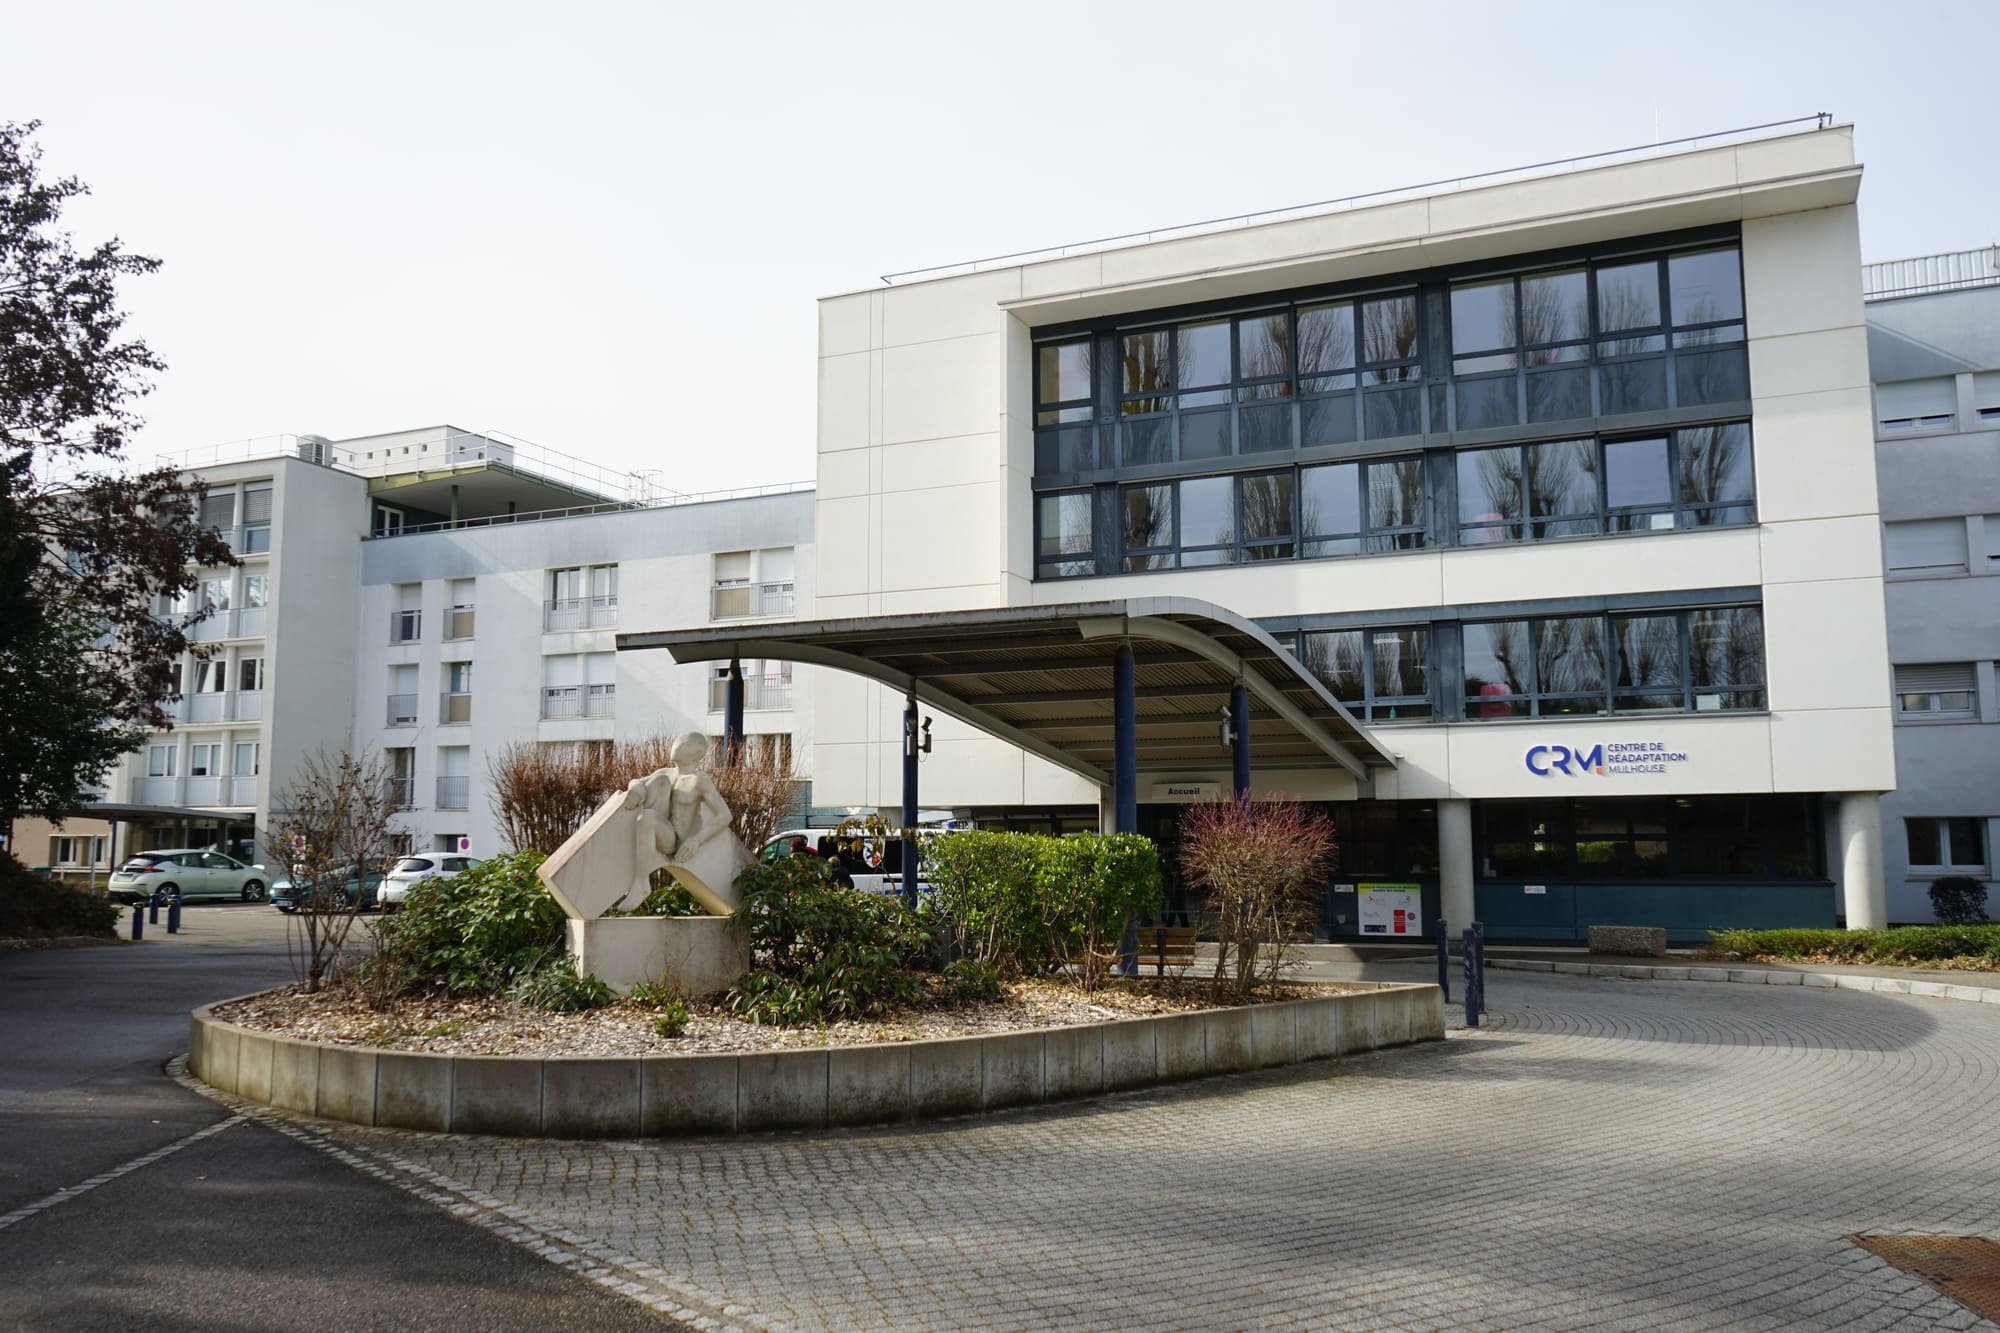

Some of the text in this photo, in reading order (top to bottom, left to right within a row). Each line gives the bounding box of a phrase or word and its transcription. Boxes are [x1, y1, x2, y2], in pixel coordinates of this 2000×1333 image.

[1607, 742, 1664, 752] CENTRE DE
[1525, 744, 1603, 776] CRM
[1608, 764, 1665, 774] MULHOUSE
[1168, 787, 1200, 795] Accueil
